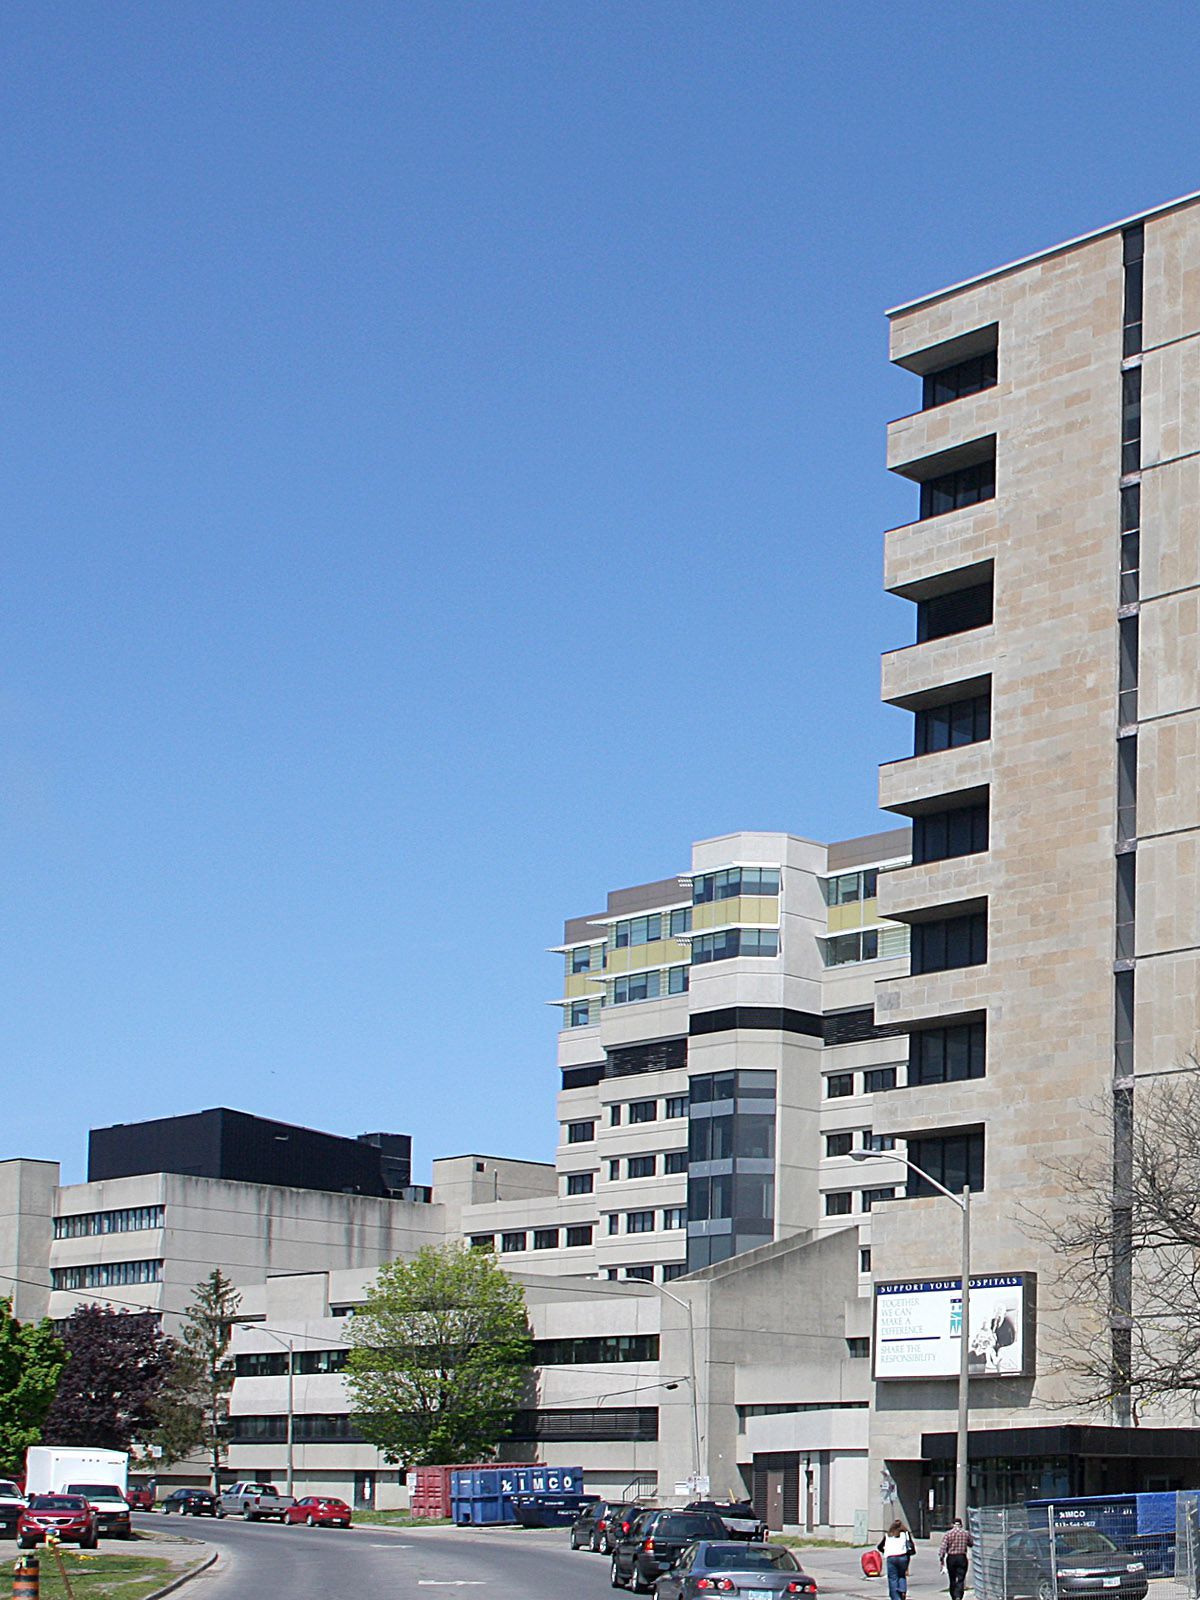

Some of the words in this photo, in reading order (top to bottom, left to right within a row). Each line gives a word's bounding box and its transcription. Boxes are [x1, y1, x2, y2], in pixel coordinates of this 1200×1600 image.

[880, 1283, 924, 1293] SUPPORT
[929, 1281, 957, 1291] YOUR
[967, 1276, 1018, 1288] OSPITALS
[880, 1297, 920, 1308] TOGETHER
[880, 1308, 894, 1317] WE
[895, 1307, 912, 1317] CAN
[881, 1317, 903, 1326] MAKE
[904, 1316, 912, 1325] A
[881, 1325, 924, 1336] DIFFERENCE
[880, 1344, 904, 1354] SHARE
[906, 1343, 922, 1353] THE
[880, 1352, 937, 1363] RESPONSIBILITY
